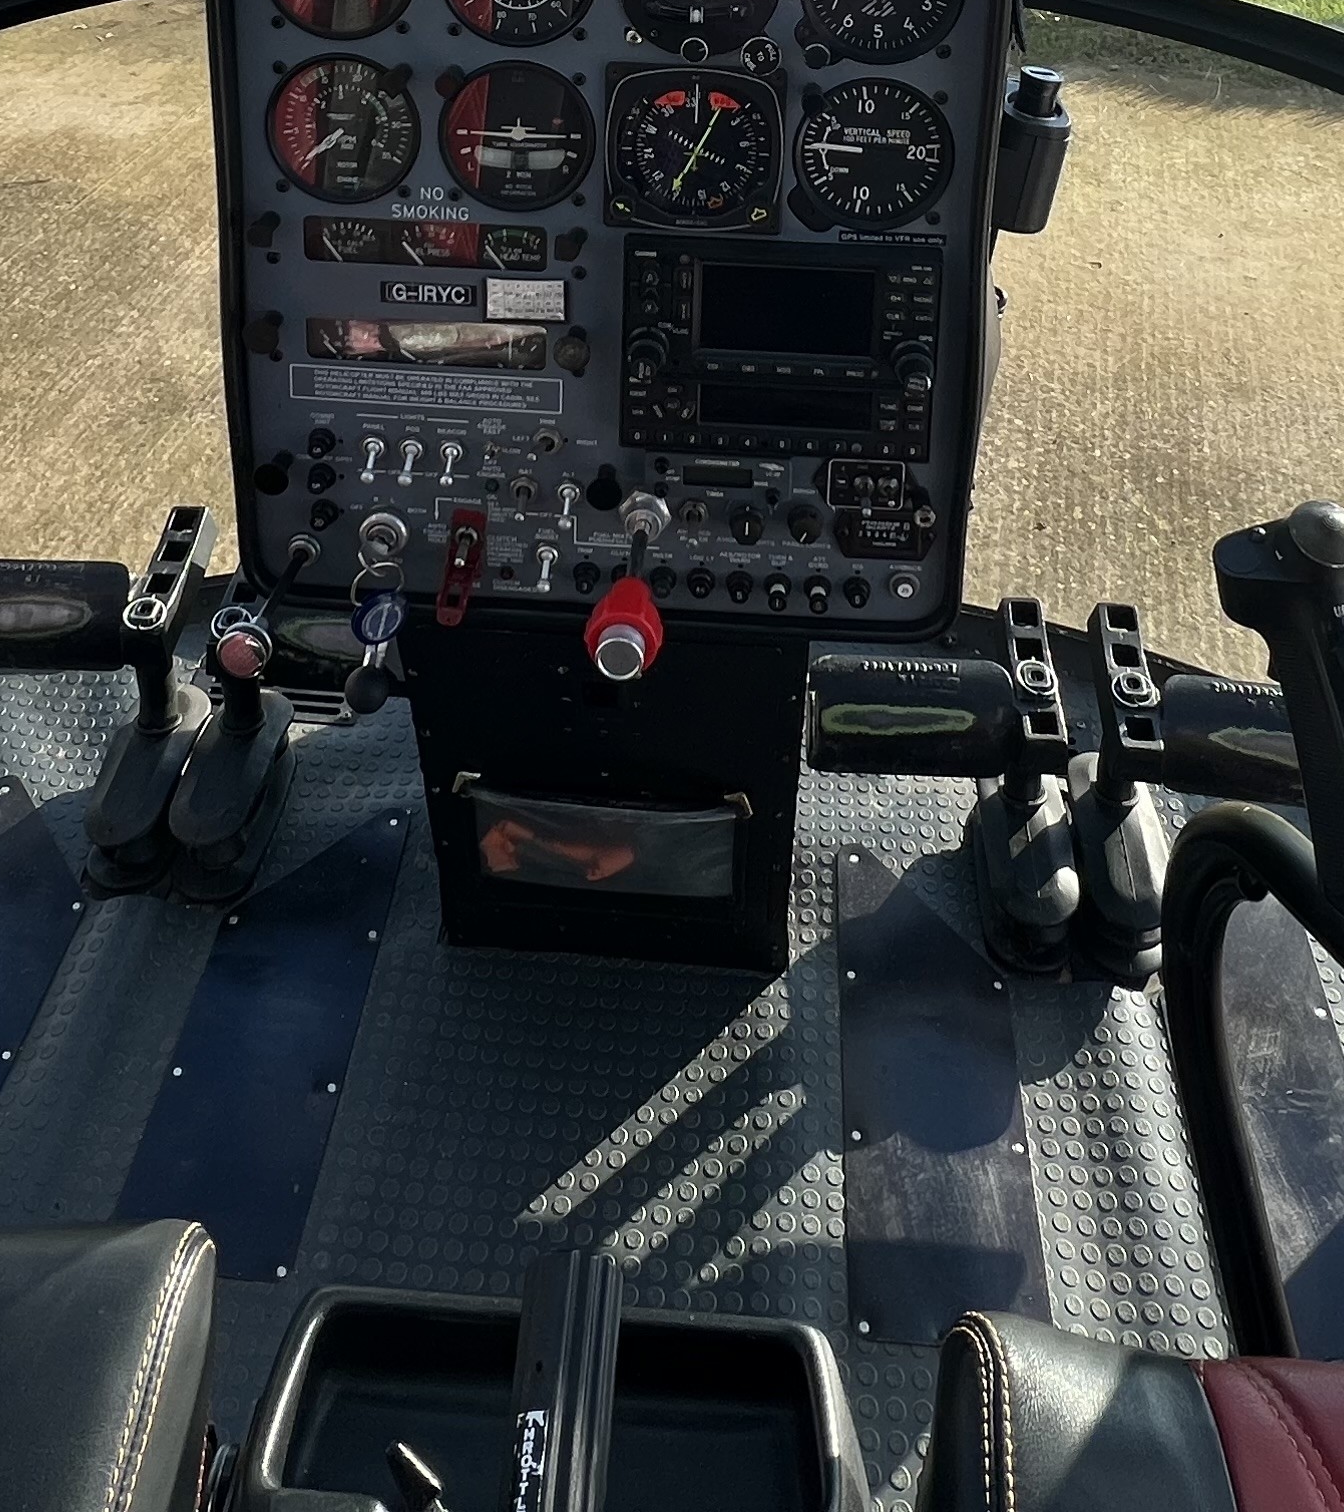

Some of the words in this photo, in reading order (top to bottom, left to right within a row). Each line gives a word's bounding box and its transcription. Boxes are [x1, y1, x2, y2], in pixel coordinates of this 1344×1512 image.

[551, 0, 562, 8] 60
[843, 14, 853, 27] 6
[903, 17, 914, 30] 4
[873, 24, 883, 38] 5
[756, 50, 765, 62] TO
[661, 105, 674, 117] 30
[857, 99, 876, 114] 10
[901, 112, 911, 120] 15
[843, 127, 880, 137] VERTICAL
[886, 129, 911, 138] SPEED
[906, 145, 926, 160] 20
[829, 166, 849, 174] DOWN
[420, 187, 444, 201] NO
[852, 186, 870, 200] 10
[392, 204, 469, 221] SMOKING
[841, 233, 858, 241] GPS
[895, 235, 910, 243] VFR
[500, 253, 520, 261] HEAD
[521, 254, 541, 262] TEMP
[392, 284, 465, 304] G-IRYC
[437, 428, 467, 436] BEACON
[516, 1411, 536, 1512] THROTTL
